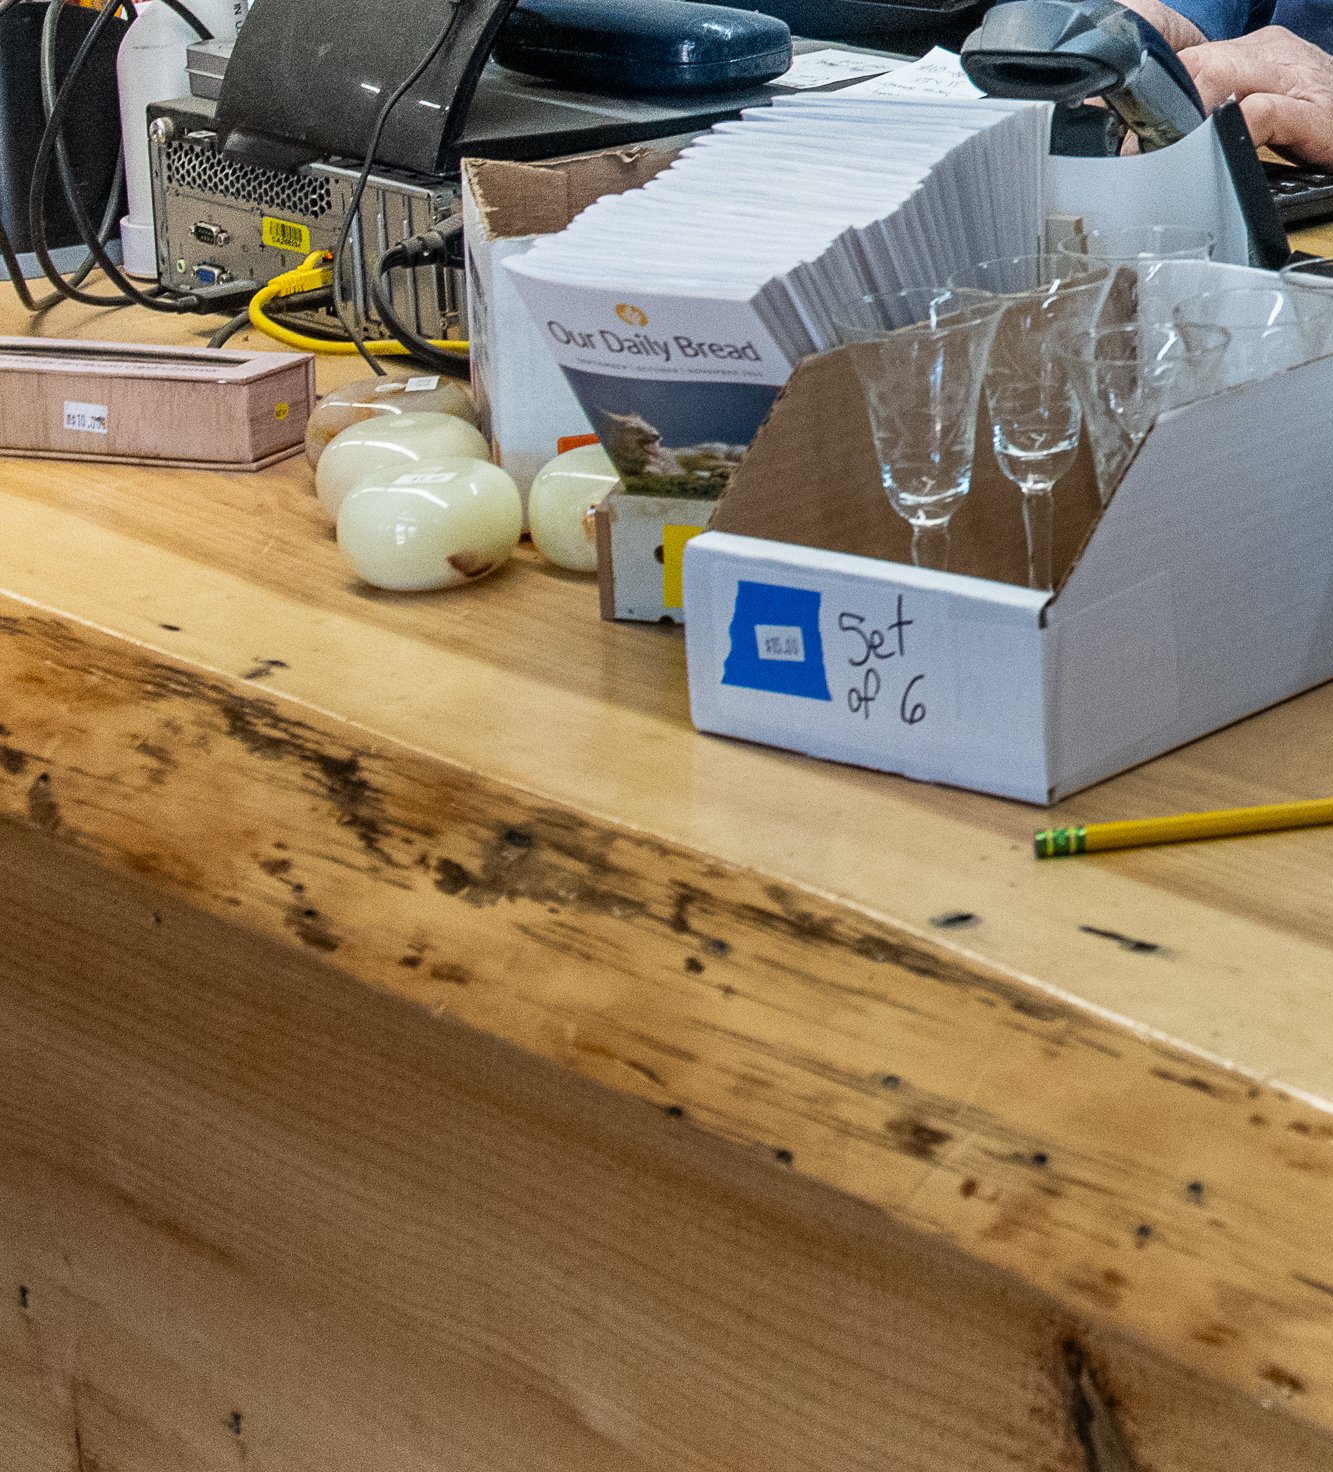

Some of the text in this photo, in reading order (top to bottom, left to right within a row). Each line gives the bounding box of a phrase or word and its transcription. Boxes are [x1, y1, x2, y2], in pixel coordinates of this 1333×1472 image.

[233, 3, 242, 16] IN
[547, 320, 762, 362] Our Daily Bread
[838, 594, 914, 666] Set
[848, 668, 926, 725] of 6
